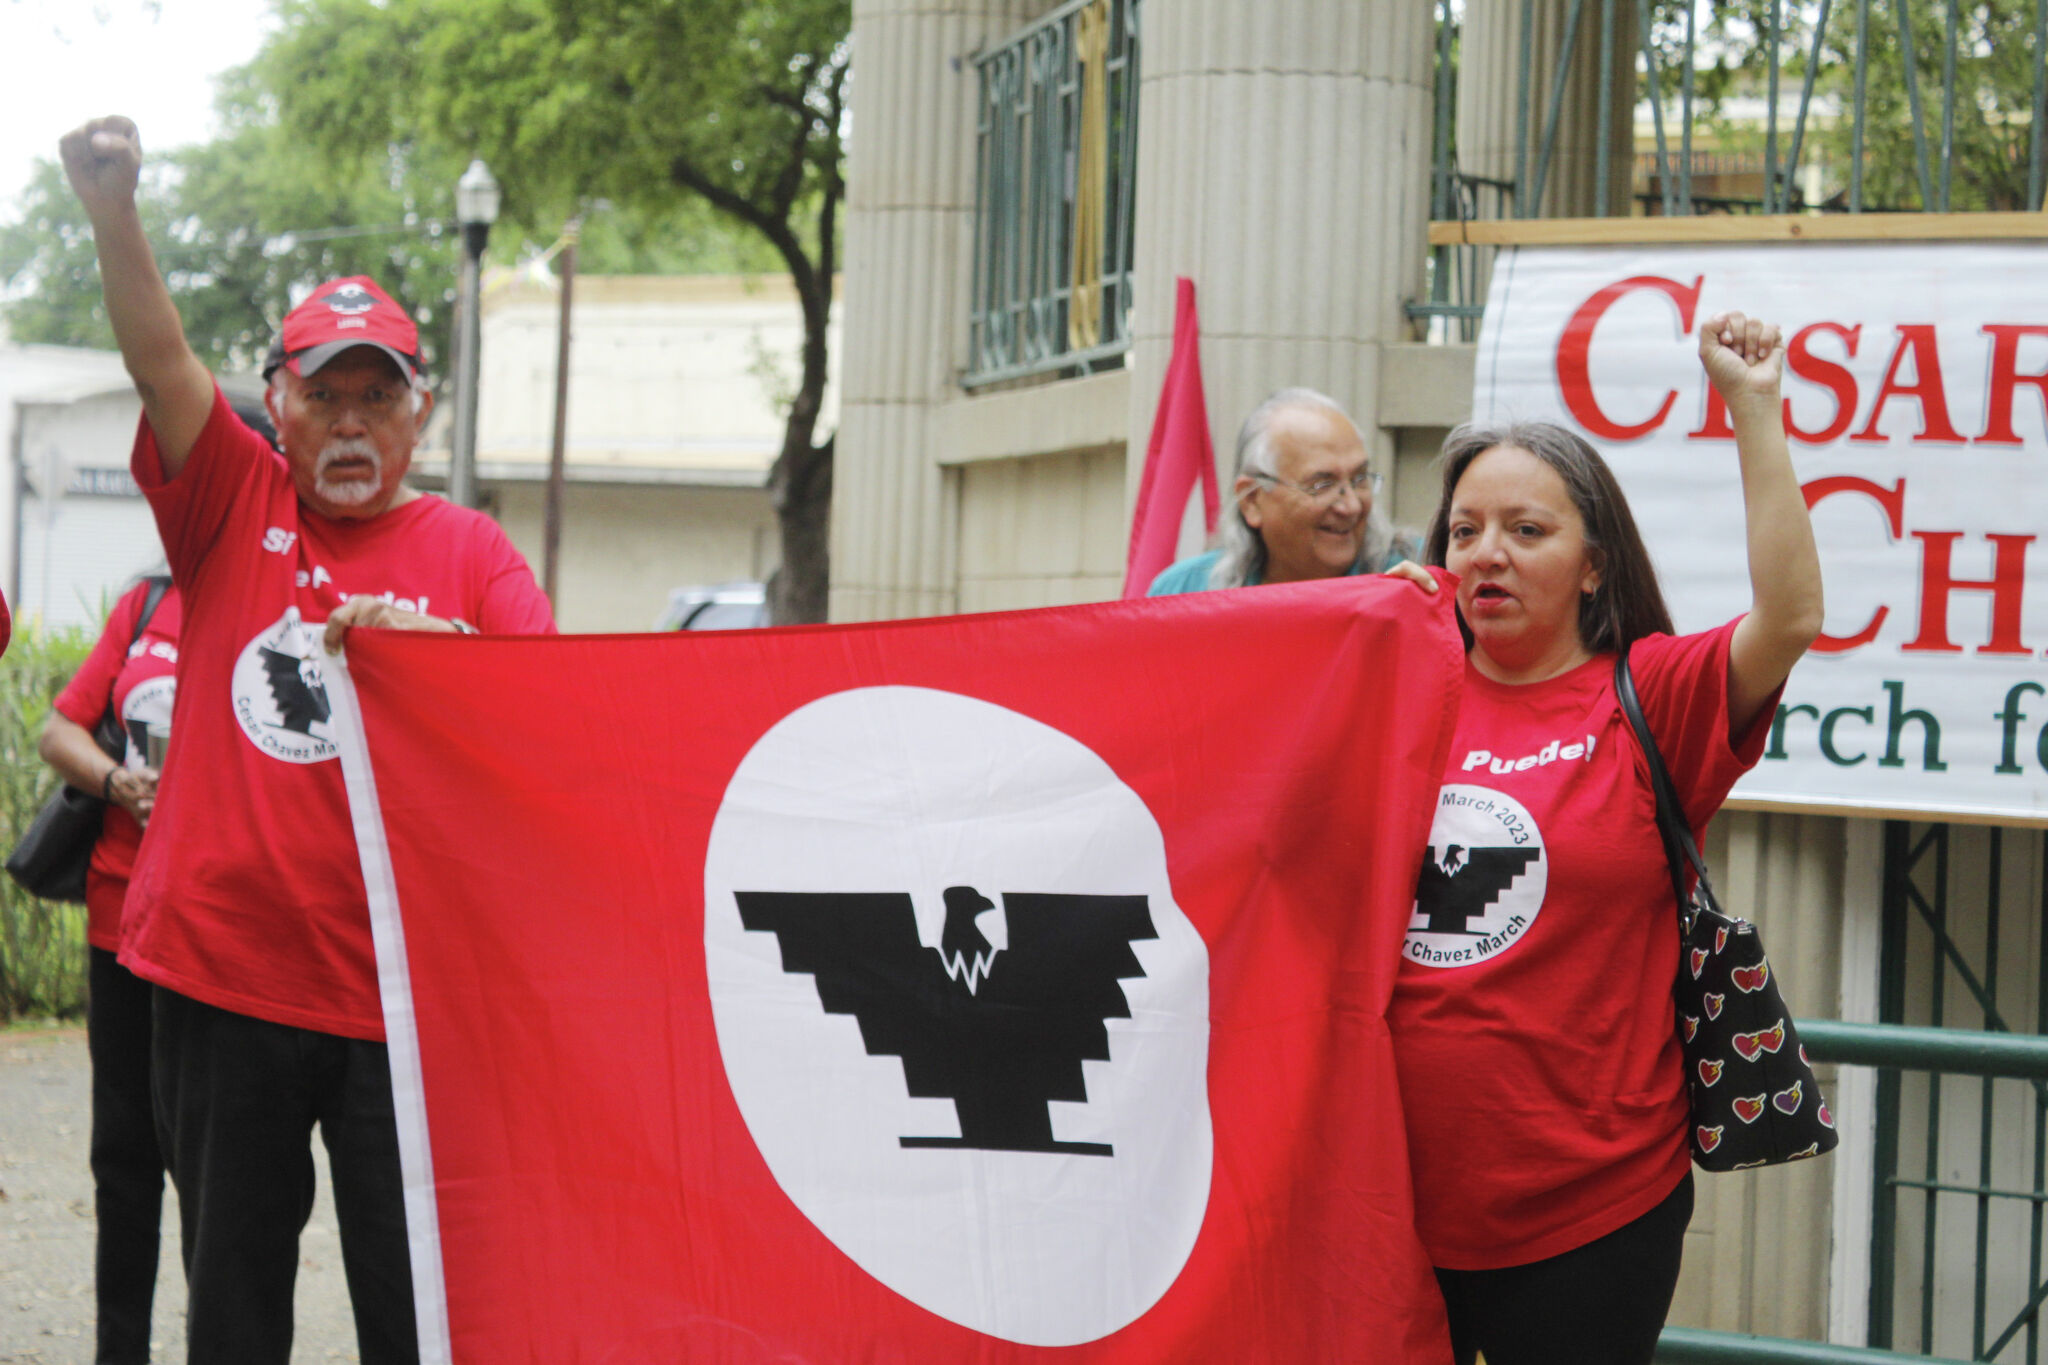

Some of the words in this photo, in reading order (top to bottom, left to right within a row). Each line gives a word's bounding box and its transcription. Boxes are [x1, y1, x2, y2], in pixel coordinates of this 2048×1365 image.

[262, 735, 310, 759] Chavez
[1764, 680, 1948, 772] rch
[1461, 734, 1596, 775] Puede!
[1441, 792, 1495, 815] March
[1495, 807, 1530, 846] 2023
[1411, 941, 1473, 962] Chavez
[1475, 914, 1527, 956] March
